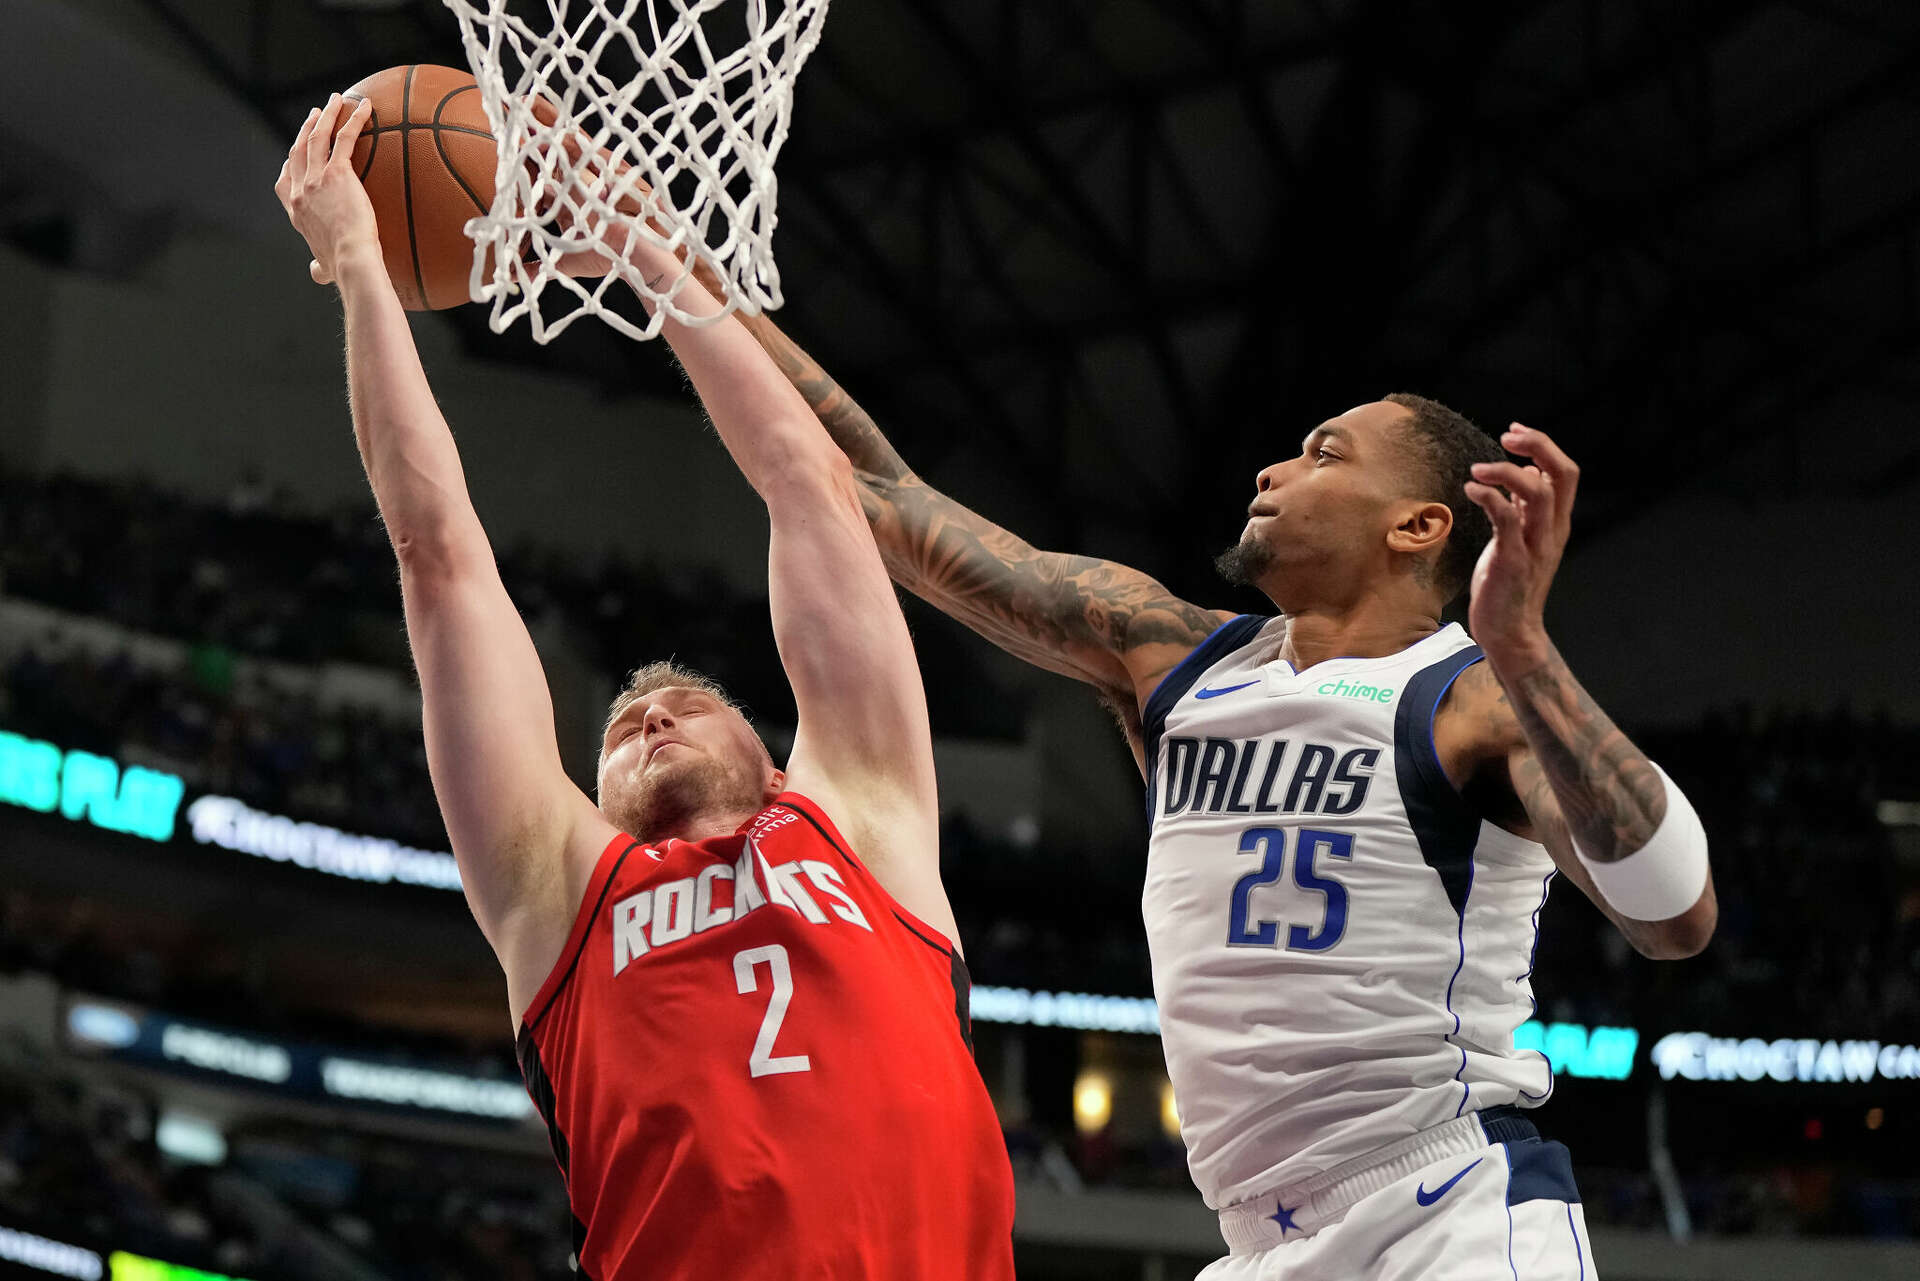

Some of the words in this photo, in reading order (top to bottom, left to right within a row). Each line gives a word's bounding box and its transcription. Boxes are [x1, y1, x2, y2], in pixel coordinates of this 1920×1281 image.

[1317, 680, 1395, 704] chime
[1162, 736, 1384, 818] DALLAS
[1226, 824, 1357, 953] 25
[733, 944, 811, 1079] 2
